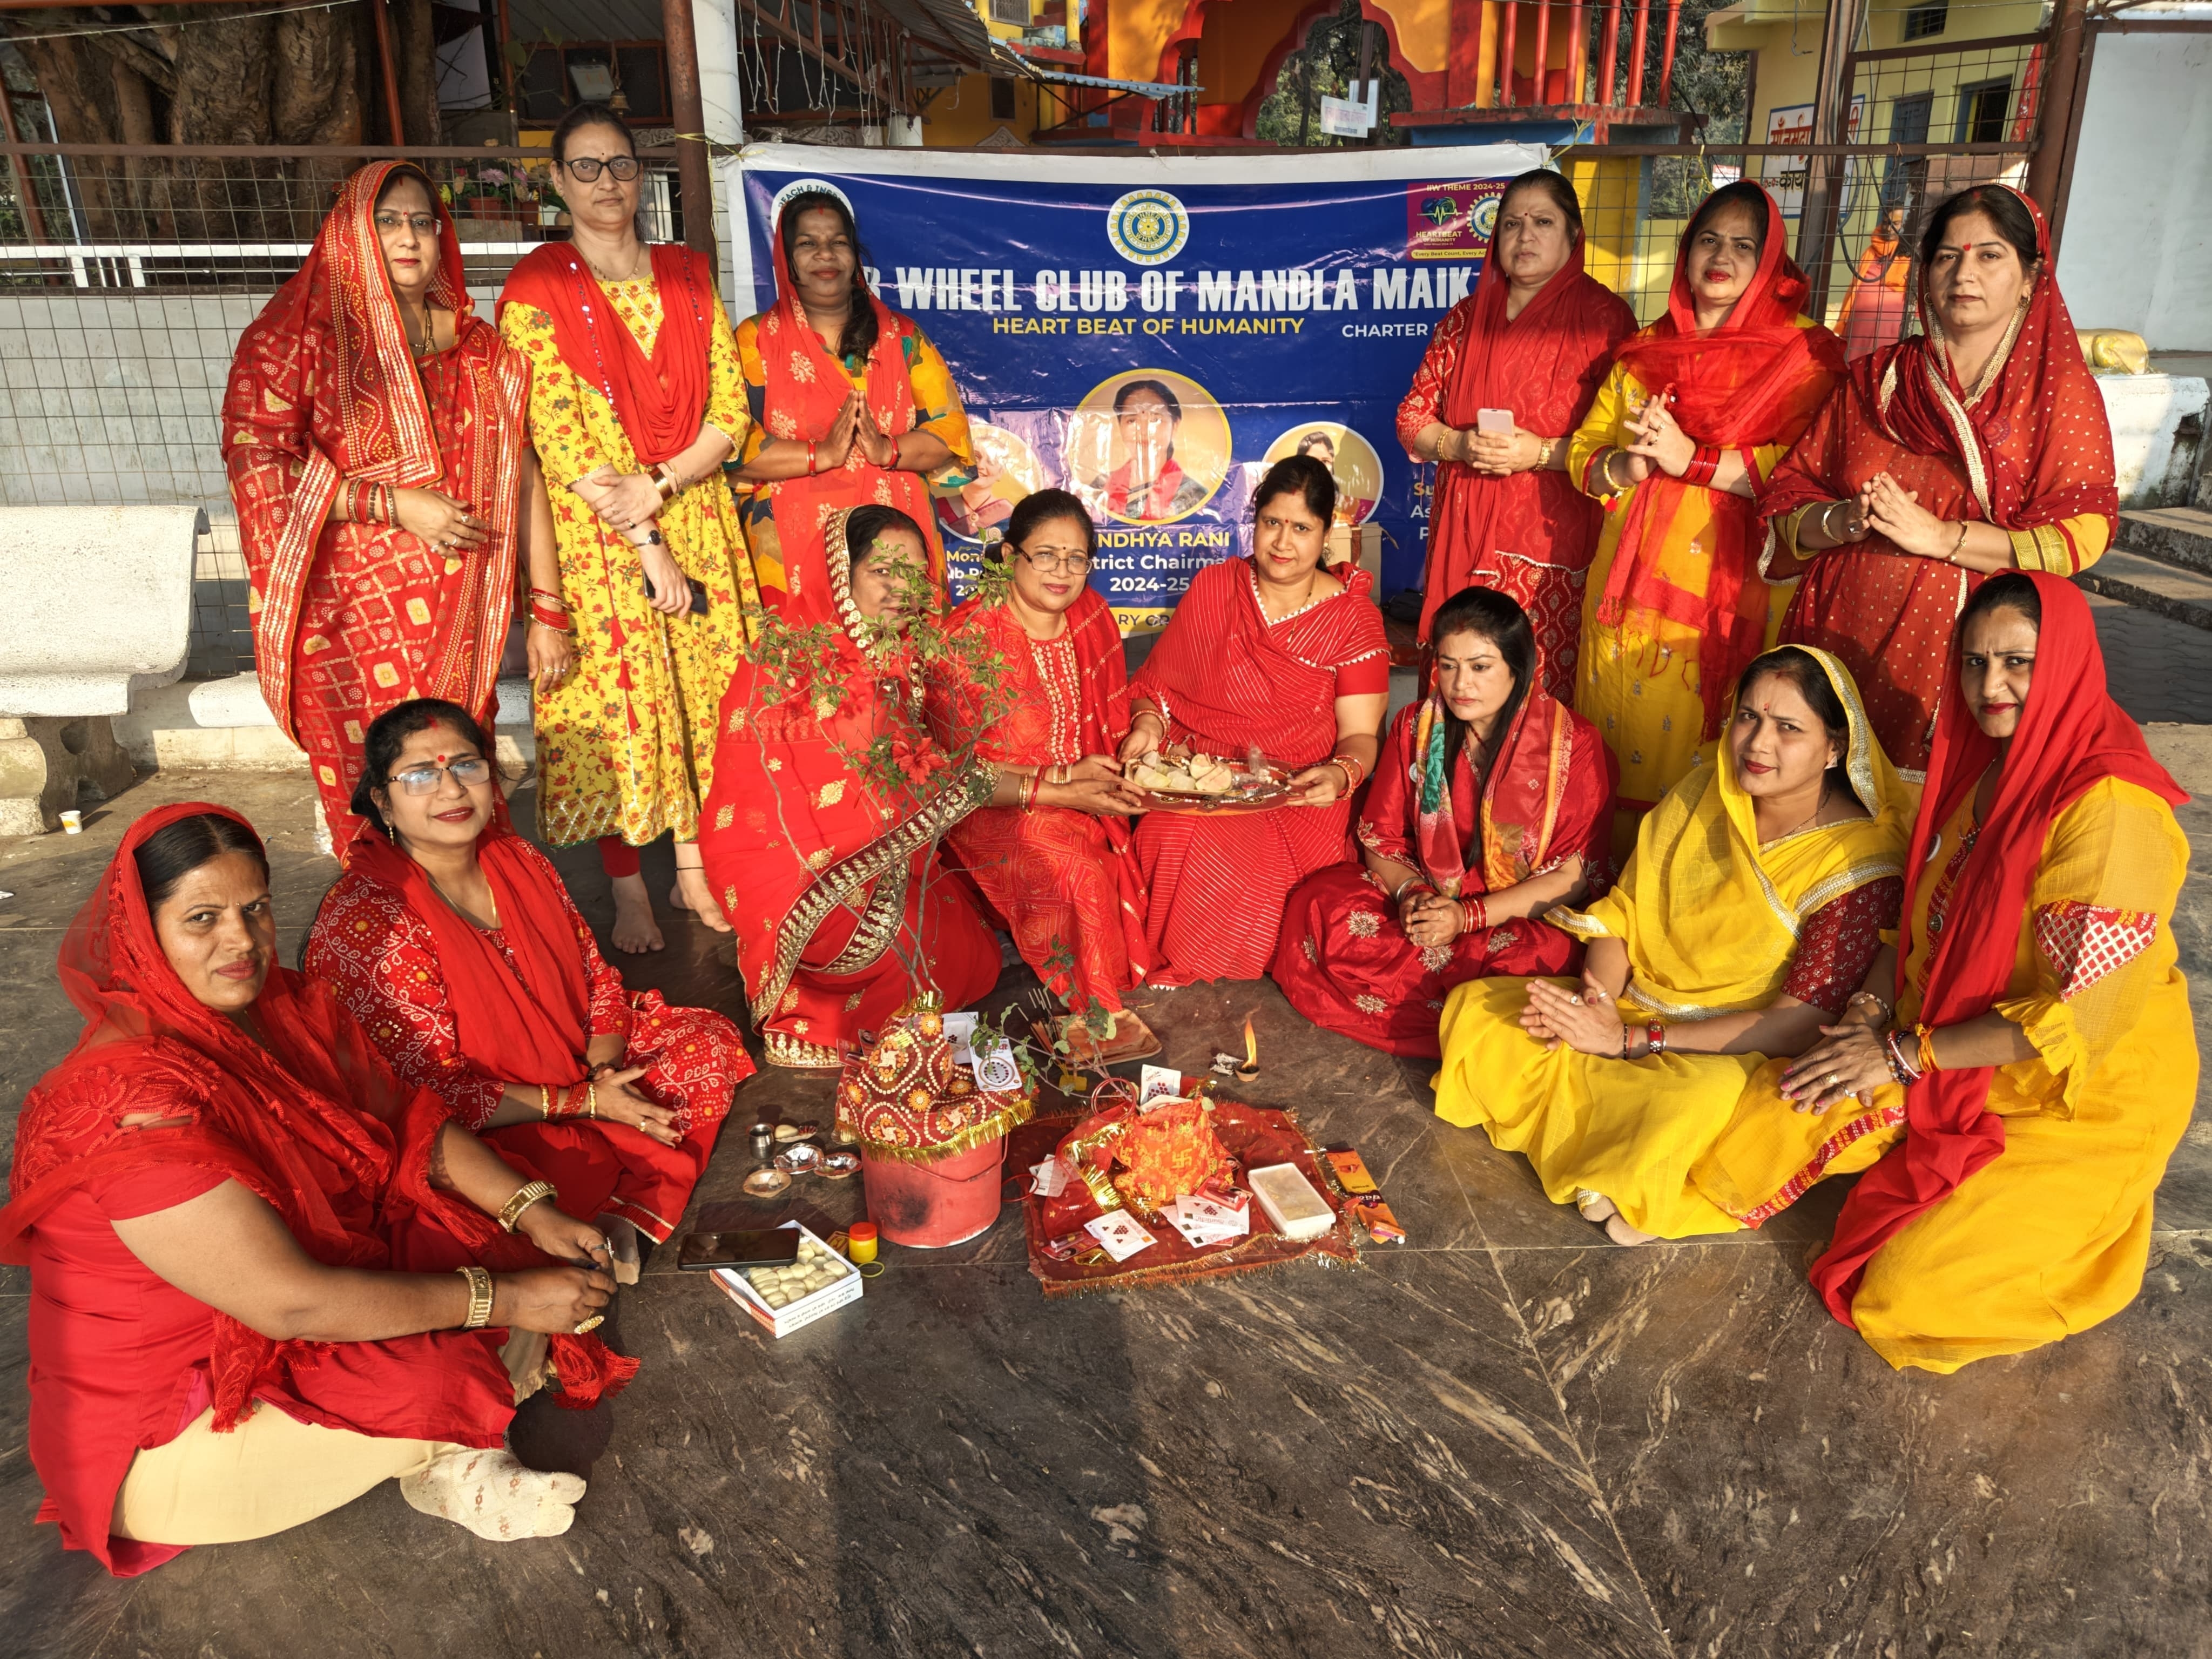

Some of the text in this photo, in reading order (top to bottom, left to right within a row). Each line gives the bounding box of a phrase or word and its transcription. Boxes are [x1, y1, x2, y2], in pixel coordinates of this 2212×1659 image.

[895, 267, 1022, 311] WHEEL
[1036, 270, 1127, 312] CLUB
[1141, 271, 1184, 312] OF
[1198, 269, 1358, 312] MANDLA
[1373, 267, 1472, 309] MAIK
[993, 318, 1305, 334] HEART BEAT OF HUMANITY
[1341, 323, 1428, 338] CHARTER
[1098, 532, 1230, 548] NDHYA RANI
[1091, 555, 1135, 570] trict
[1110, 577, 1190, 591] 2024-25
